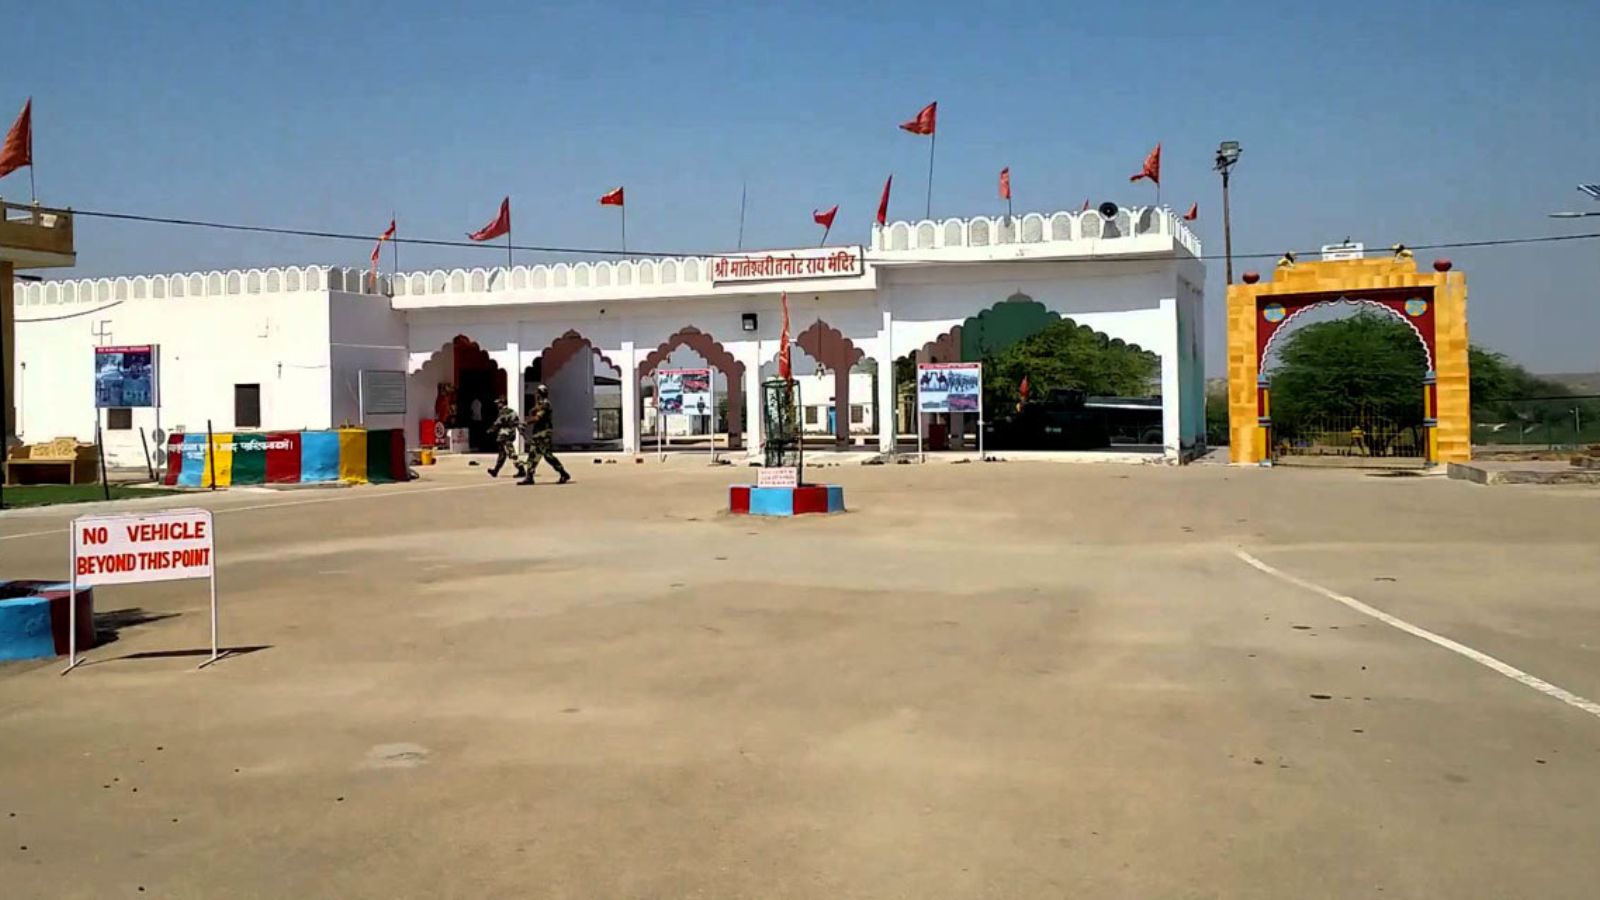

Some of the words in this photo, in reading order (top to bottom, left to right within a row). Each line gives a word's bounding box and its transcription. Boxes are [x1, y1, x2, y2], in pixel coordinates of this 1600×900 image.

[715, 258, 728, 278] श्री
[775, 253, 803, 276] तनोट
[806, 257, 826, 275] राय
[828, 251, 856, 273] मंदिर
[82, 527, 108, 545] NO
[127, 521, 206, 543] VEHICLE
[77, 554, 137, 576] BEYOND
[138, 551, 171, 570] THIS
[172, 548, 211, 569] POINT
